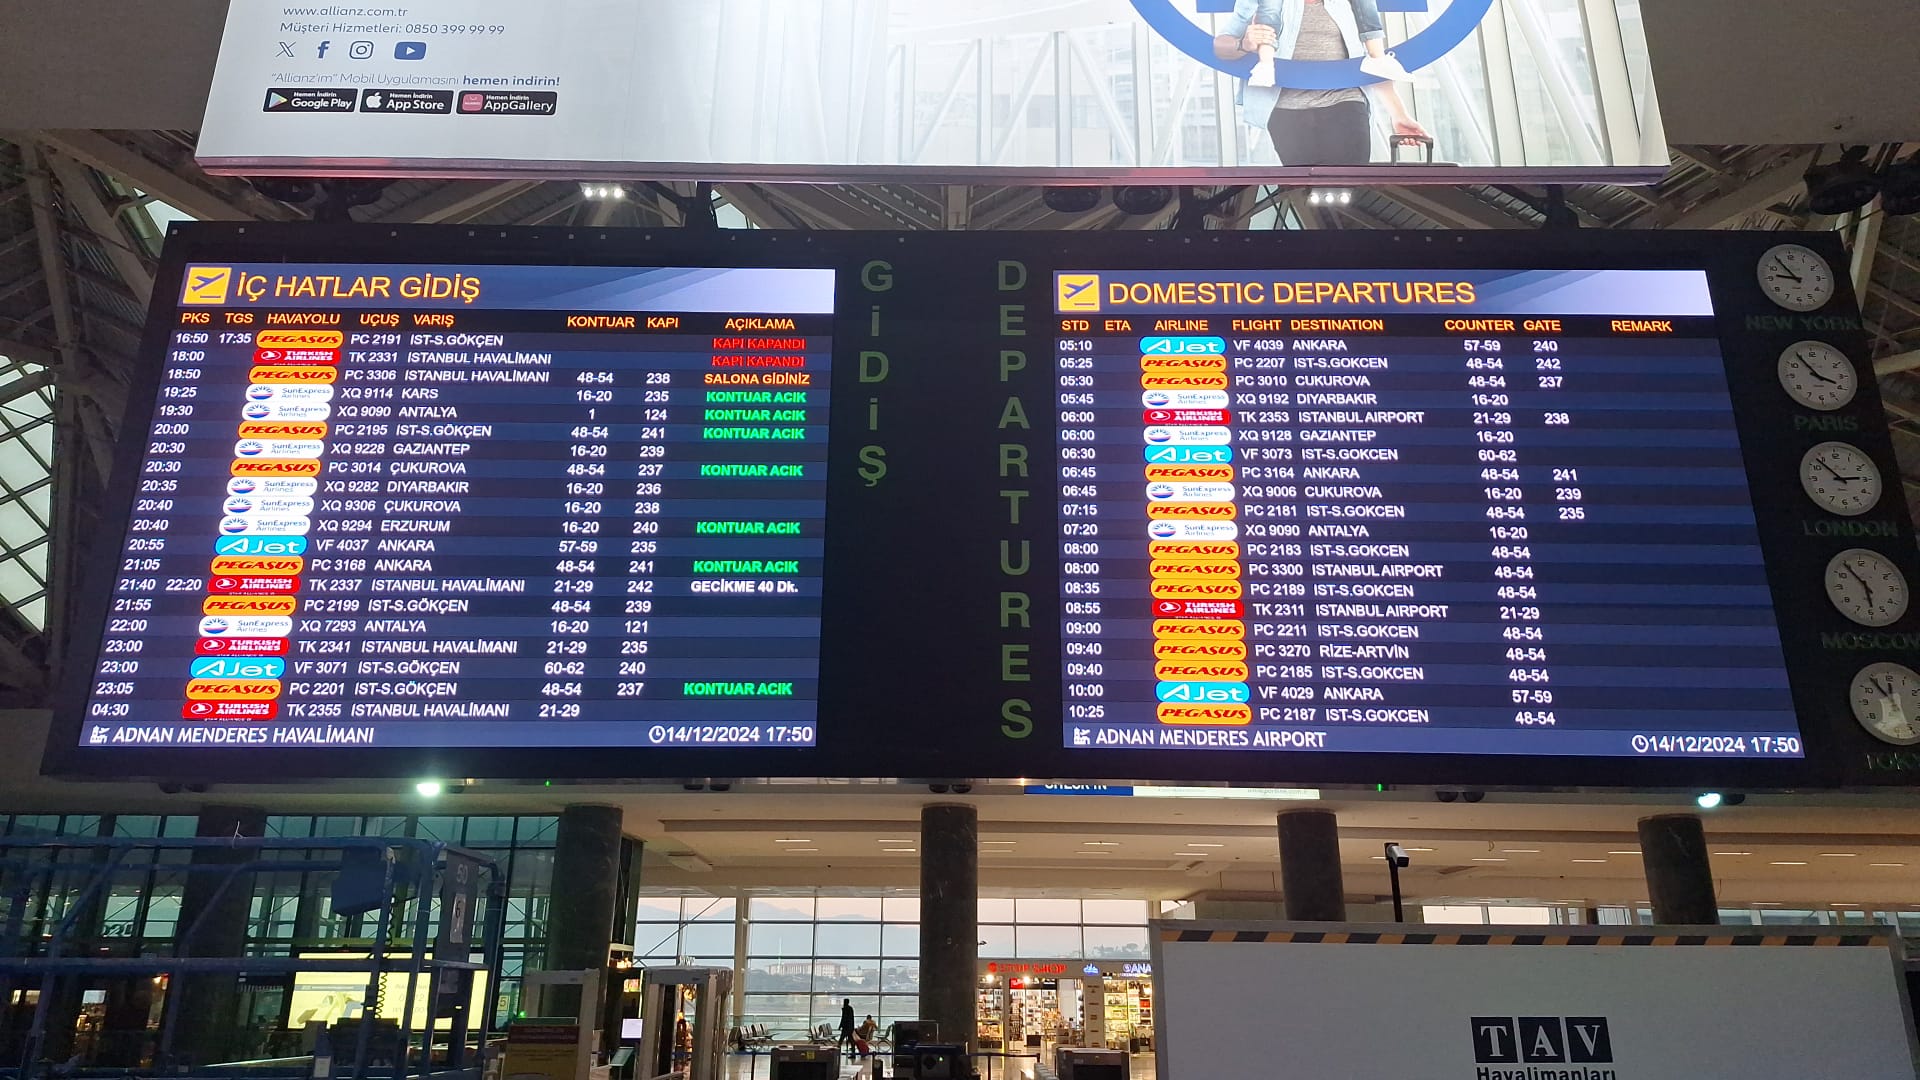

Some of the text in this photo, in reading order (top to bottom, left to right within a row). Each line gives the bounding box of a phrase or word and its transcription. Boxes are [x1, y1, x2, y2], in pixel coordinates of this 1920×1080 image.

[283, 7, 408, 16] www.allianz.com.tr
[280, 22, 504, 34] Müşteri Hizmetleri: 0850 399 99 99
[340, 73, 374, 84] Mobil
[463, 76, 508, 86] hemen
[512, 76, 560, 86] indirin!
[291, 98, 352, 110] Google Play
[386, 100, 444, 110] App Store
[485, 100, 553, 112] AppGallery
[236, 272, 481, 302] İÇ HATLAR GİDİŞ
[1108, 282, 1476, 304] DOMESTIC DEPARTURES
[181, 312, 795, 332] PKS TGS HAVAYOLU UÇUŞ VARIŞ KONTUAR KAPI AÇIKLAMA
[1061, 320, 1672, 332] STD ETA AIRLINE FLIGHT DESTINATION COUNTER GATE REMARK
[1745, 315, 1792, 331] NEW
[176, 334, 208, 344] 16:50
[219, 334, 252, 344] 17:35
[259, 334, 339, 344] PEGASUS
[350, 334, 368, 345] PC
[372, 334, 402, 345] 2191
[713, 338, 745, 349] KAPI
[748, 338, 806, 350] KAPANDI
[1060, 339, 1558, 352] 05:10 AJet VF 4039 ANKARA 57-59 240
[168, 369, 201, 380] 18:50
[253, 370, 334, 379] PEGASUS
[345, 370, 362, 380] PC
[366, 370, 396, 380] 3306
[576, 373, 614, 384] 48-54
[646, 373, 671, 384] 238
[704, 373, 760, 385] SALONA
[762, 372, 810, 385] GİDİNİZ
[159, 405, 193, 416] 19:30
[337, 406, 357, 418] XQ
[360, 406, 391, 418] 9090
[398, 406, 457, 418] ANTALYA
[588, 409, 596, 420] 1
[644, 409, 667, 420] 124
[704, 410, 770, 422] KONTUAR
[772, 410, 806, 422] ACIK
[1794, 415, 1858, 431] PARIS
[998, 260, 1033, 739] DEPARTURES
[1803, 520, 1898, 536] LONDON
[128, 538, 656, 554] 20:55 AJet VF 4037 ANKARA 57-59 235
[120, 579, 156, 591] 21:40
[166, 579, 202, 591] 22:20
[310, 580, 325, 591] TK
[328, 580, 362, 591] 2337
[554, 580, 593, 592] 21-29
[627, 580, 653, 592] 242
[690, 580, 755, 592] GECİKME
[758, 581, 774, 592] 40
[777, 581, 798, 592] Dk.
[1066, 602, 1100, 613] 08:55
[1254, 604, 1270, 616] TK
[1274, 604, 1304, 616] 2311
[1316, 604, 1384, 617] ISTANBUL
[1384, 604, 1448, 617] AIRPORT
[1500, 606, 1540, 619] 21-29
[1066, 643, 1102, 654] 09:40
[1158, 645, 1242, 656] PEGASUS
[1254, 644, 1274, 656] PC
[1277, 644, 1310, 656] 3270
[1506, 648, 1546, 660] 48-54
[96, 682, 134, 694] 23:05
[190, 684, 277, 695] PEGASUS
[290, 683, 308, 695] PC
[310, 683, 344, 695] 2201
[542, 684, 582, 696] 48-54
[617, 684, 644, 696] 237
[684, 683, 754, 695] KONTUAR
[757, 683, 792, 695] ACIK
[1069, 706, 1556, 725] 10:25 PEGASUS PC 2187 IST-S.GOKCEN 48-54
[113, 724, 374, 743] ADNAN MENDERES HAVALİMANI
[666, 726, 812, 742] 14/12/2024 17:50
[1096, 728, 1327, 748] ADNAN MENDERES AIRPORT
[1648, 736, 1800, 752] 14/12/2024 17:50
[1478, 1023, 1603, 1059] TAV
[1477, 1066, 1616, 1080] Havalimanları
